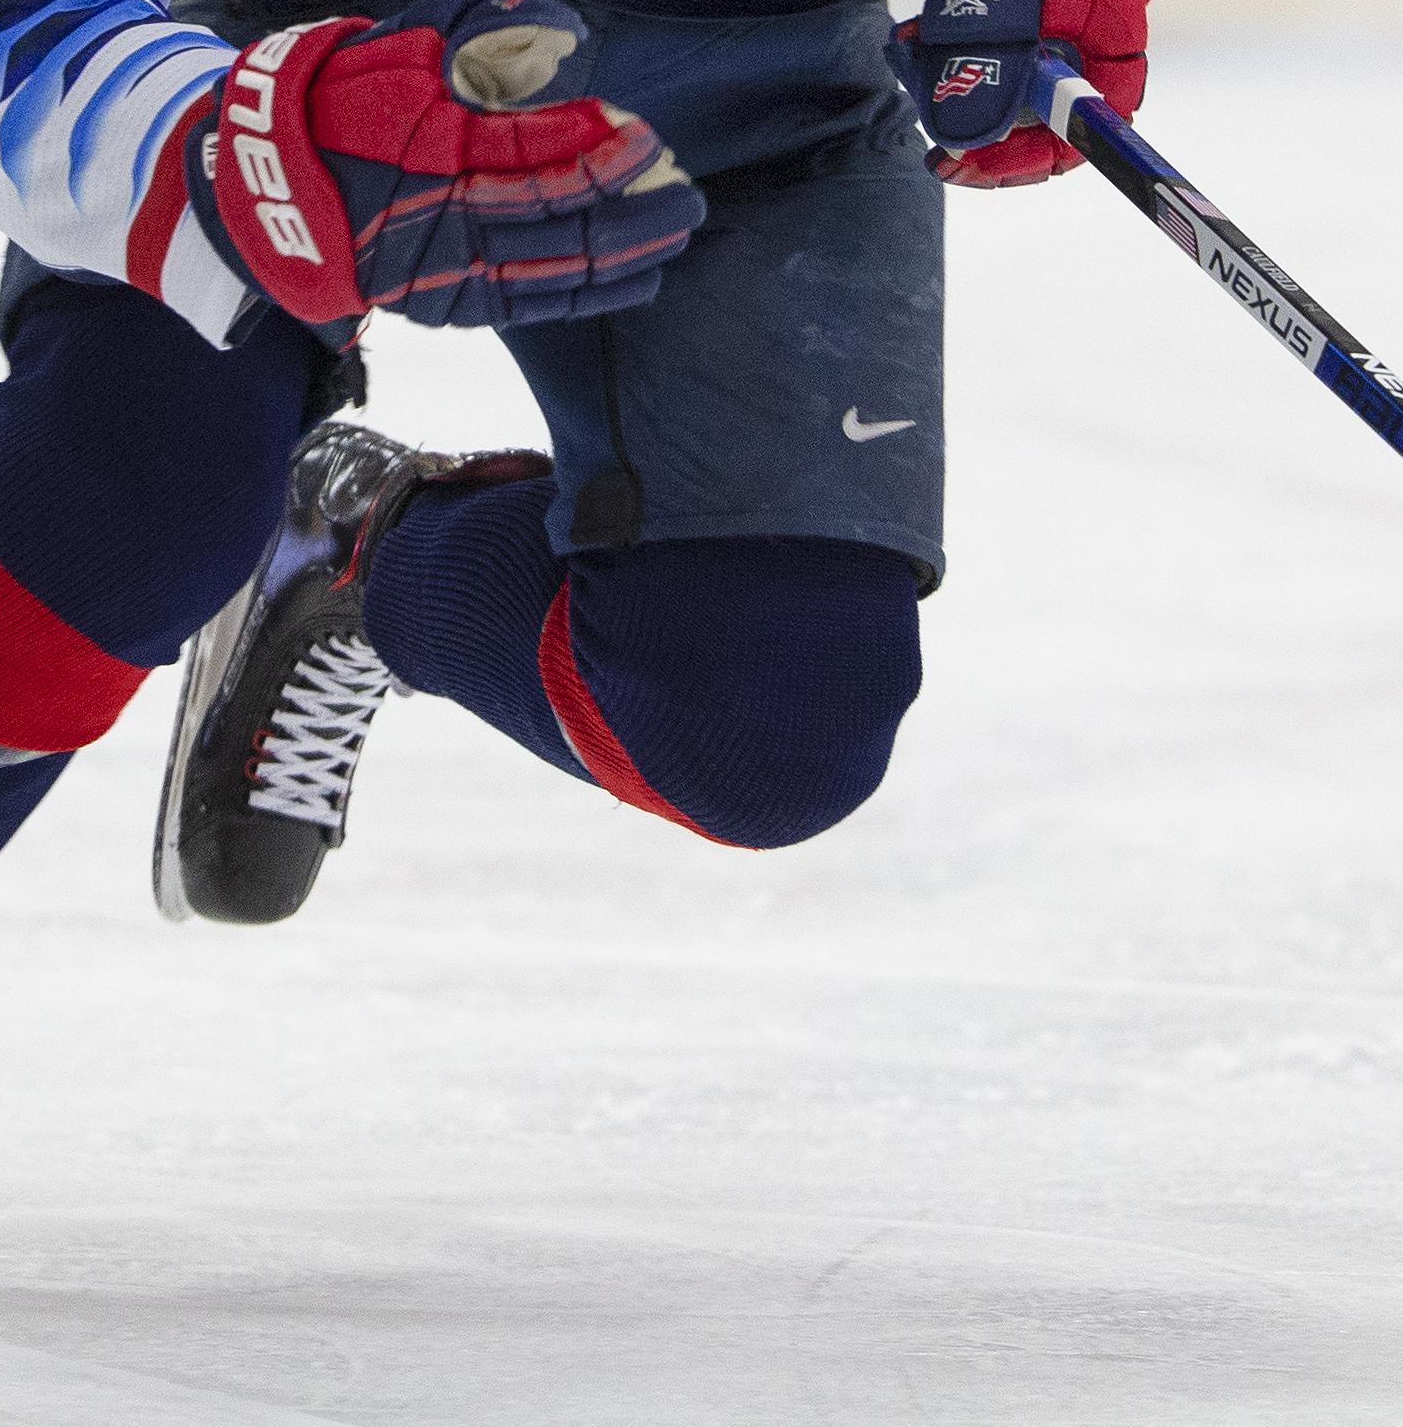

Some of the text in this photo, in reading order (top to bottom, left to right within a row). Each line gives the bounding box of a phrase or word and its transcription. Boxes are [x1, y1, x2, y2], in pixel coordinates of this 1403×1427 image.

[933, 56, 1001, 102] USA
[228, 16, 340, 265] BAUE
[1208, 248, 1313, 358] NEXUS
